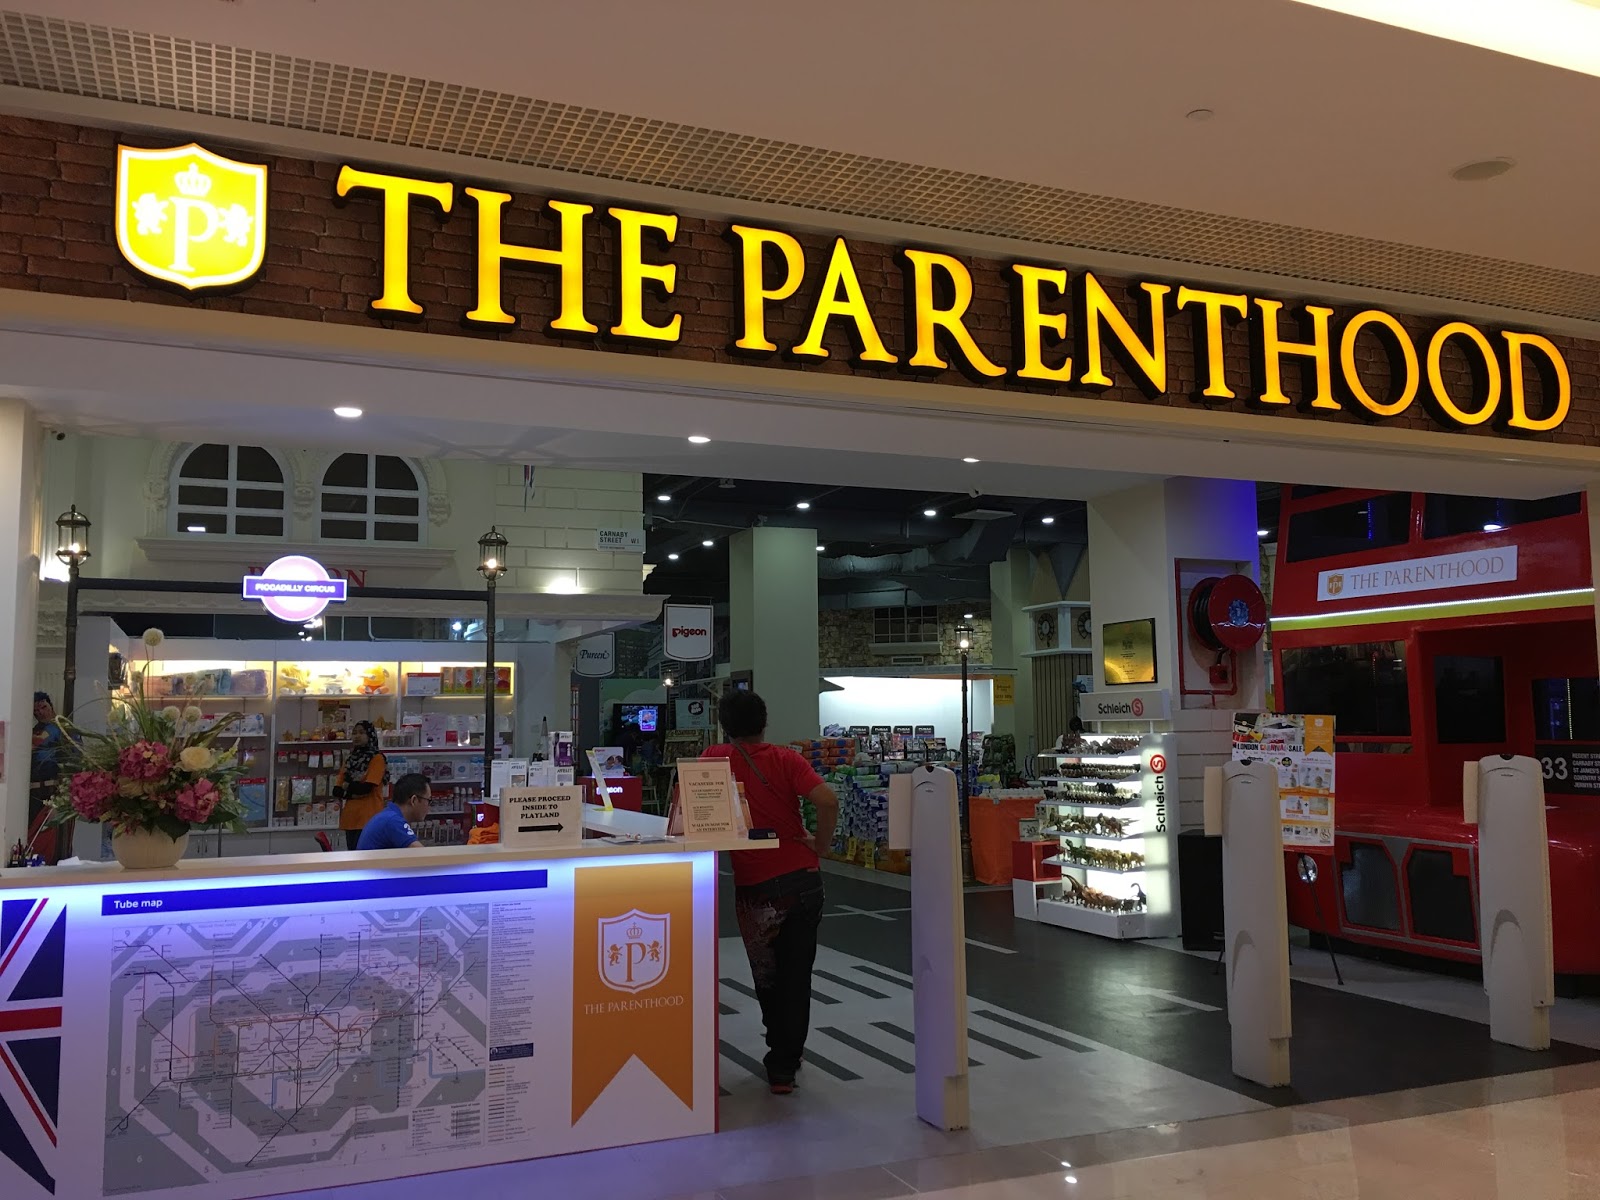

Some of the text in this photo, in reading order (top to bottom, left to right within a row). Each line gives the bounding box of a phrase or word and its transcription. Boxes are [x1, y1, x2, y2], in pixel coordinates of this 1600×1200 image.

[169, 197, 222, 272] P
[336, 165, 1571, 432] THE PARENTHOOD
[1350, 556, 1504, 590] THE PARENTHOOD
[255, 583, 336, 593] PICCADILLY CIRCUS
[672, 626, 707, 638] pigeon
[1098, 701, 1131, 716] Schleich
[1237, 743, 1259, 751] LONDON
[1541, 757, 1568, 780] 33
[1156, 775, 1166, 833] Schleich
[114, 899, 163, 909] Tube map
[625, 942, 646, 983] P
[584, 995, 684, 1015] THE PARENTHOOD
